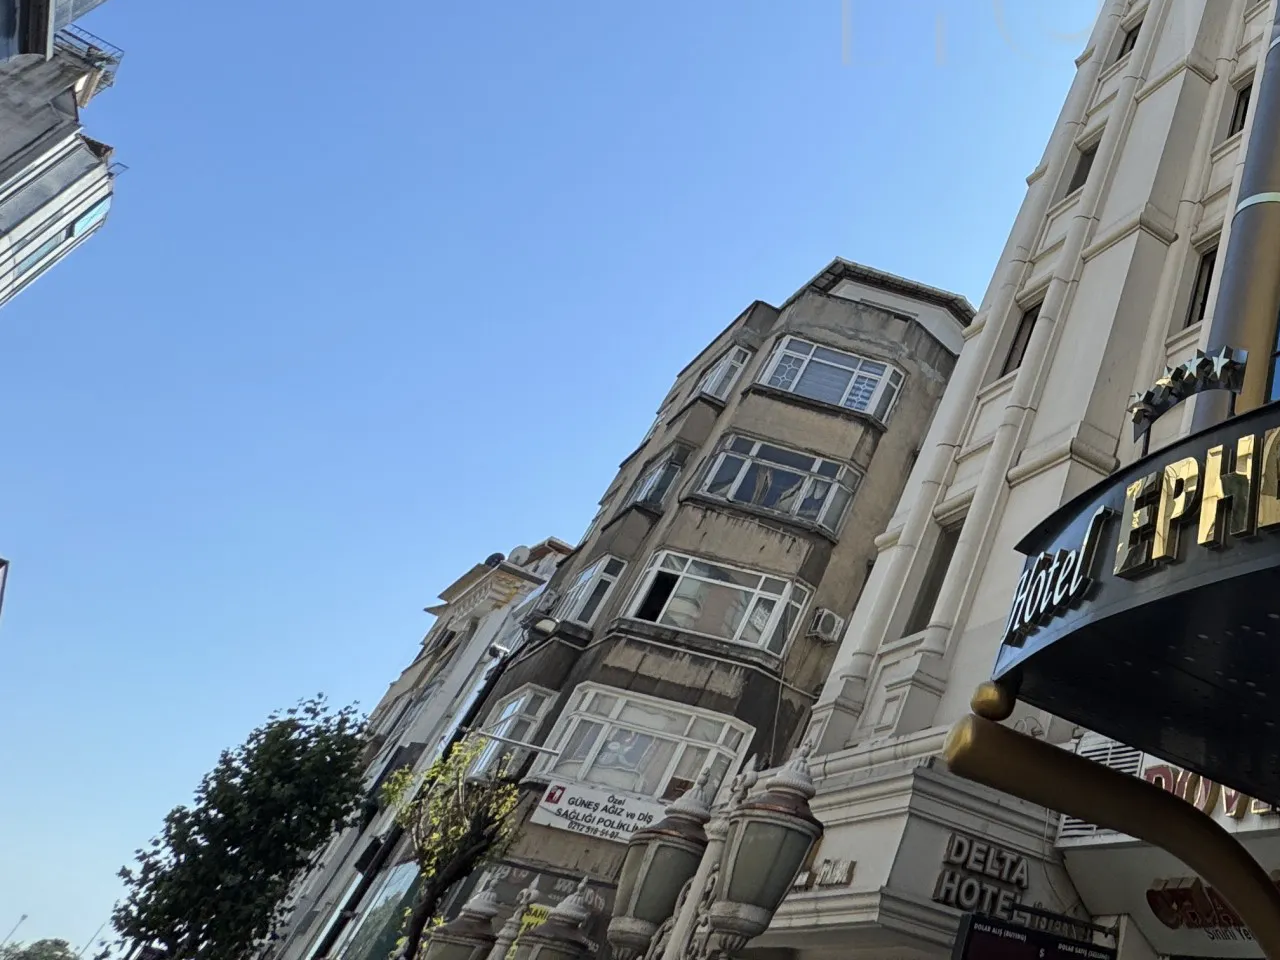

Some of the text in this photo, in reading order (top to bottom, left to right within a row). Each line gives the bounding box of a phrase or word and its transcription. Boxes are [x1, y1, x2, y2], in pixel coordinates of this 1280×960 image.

[1001, 505, 1104, 644] Hotel
[554, 807, 596, 824] SAĞLIĞI
[567, 796, 654, 824] GÜNEŞ AĞIZ ve DİŞ
[607, 794, 626, 806] Özel
[945, 832, 1029, 889] DELTA
[933, 868, 1029, 927] HOTEL
